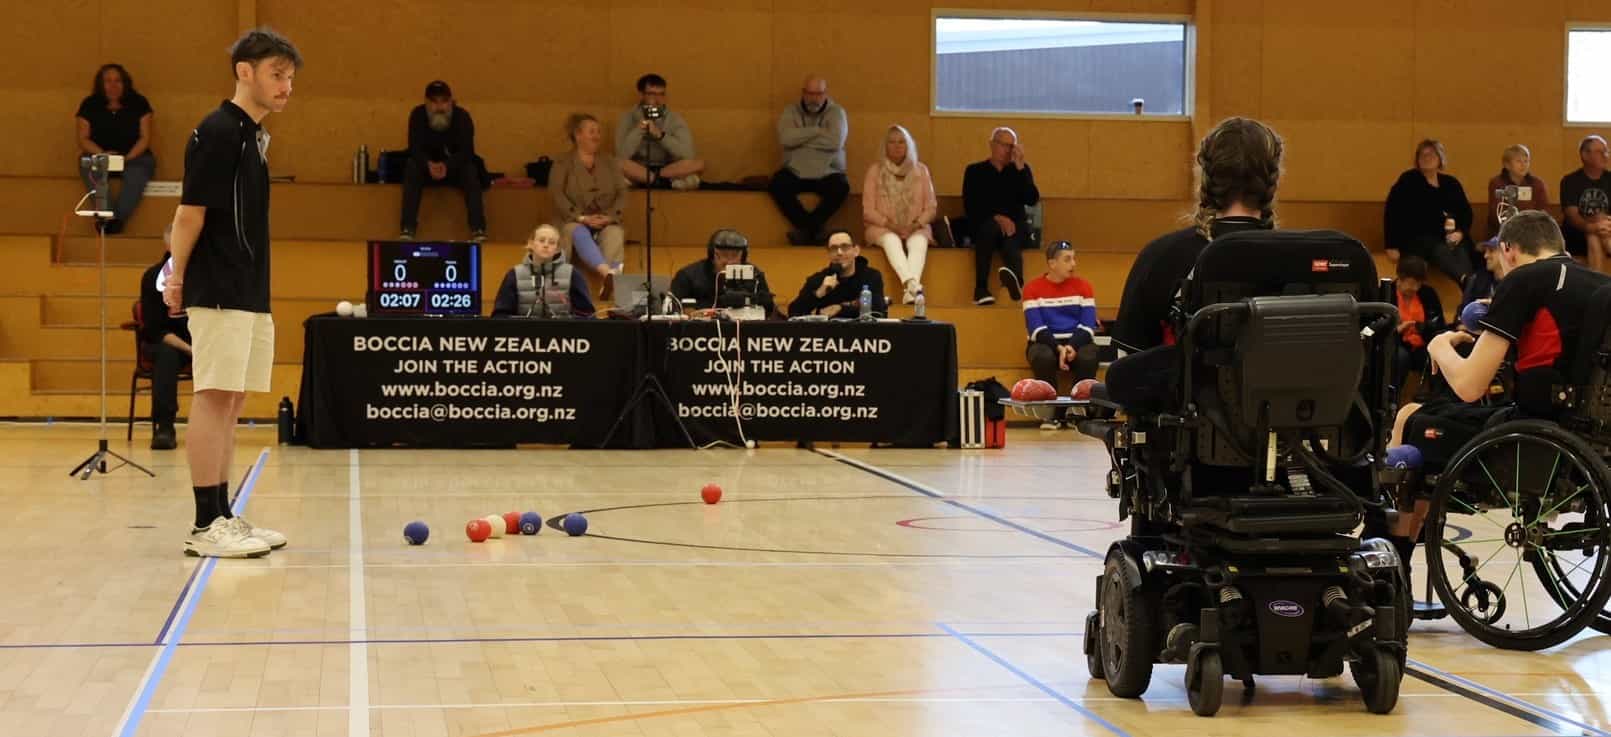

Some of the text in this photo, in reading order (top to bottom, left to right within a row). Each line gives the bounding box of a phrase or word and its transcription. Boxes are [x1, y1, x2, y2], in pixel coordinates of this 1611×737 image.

[395, 264, 406, 281] 0
[445, 265, 457, 282] 0
[380, 293, 420, 307] 02:07
[431, 293, 471, 308] 02:26
[353, 336, 590, 353] BOCCIA NEW ZEALAND
[747, 337, 793, 351] NEW
[800, 338, 891, 353] ZEALAND
[394, 360, 551, 374] JOIN THE ACTION
[704, 360, 854, 373] JOIN THE ACTION
[381, 381, 563, 400] www.boccia.org.nz
[693, 381, 865, 399] www.boccia.org.nz
[367, 404, 576, 422] boccia@boccia.org.nz
[679, 403, 877, 420] boccia@boccia.org.nz
